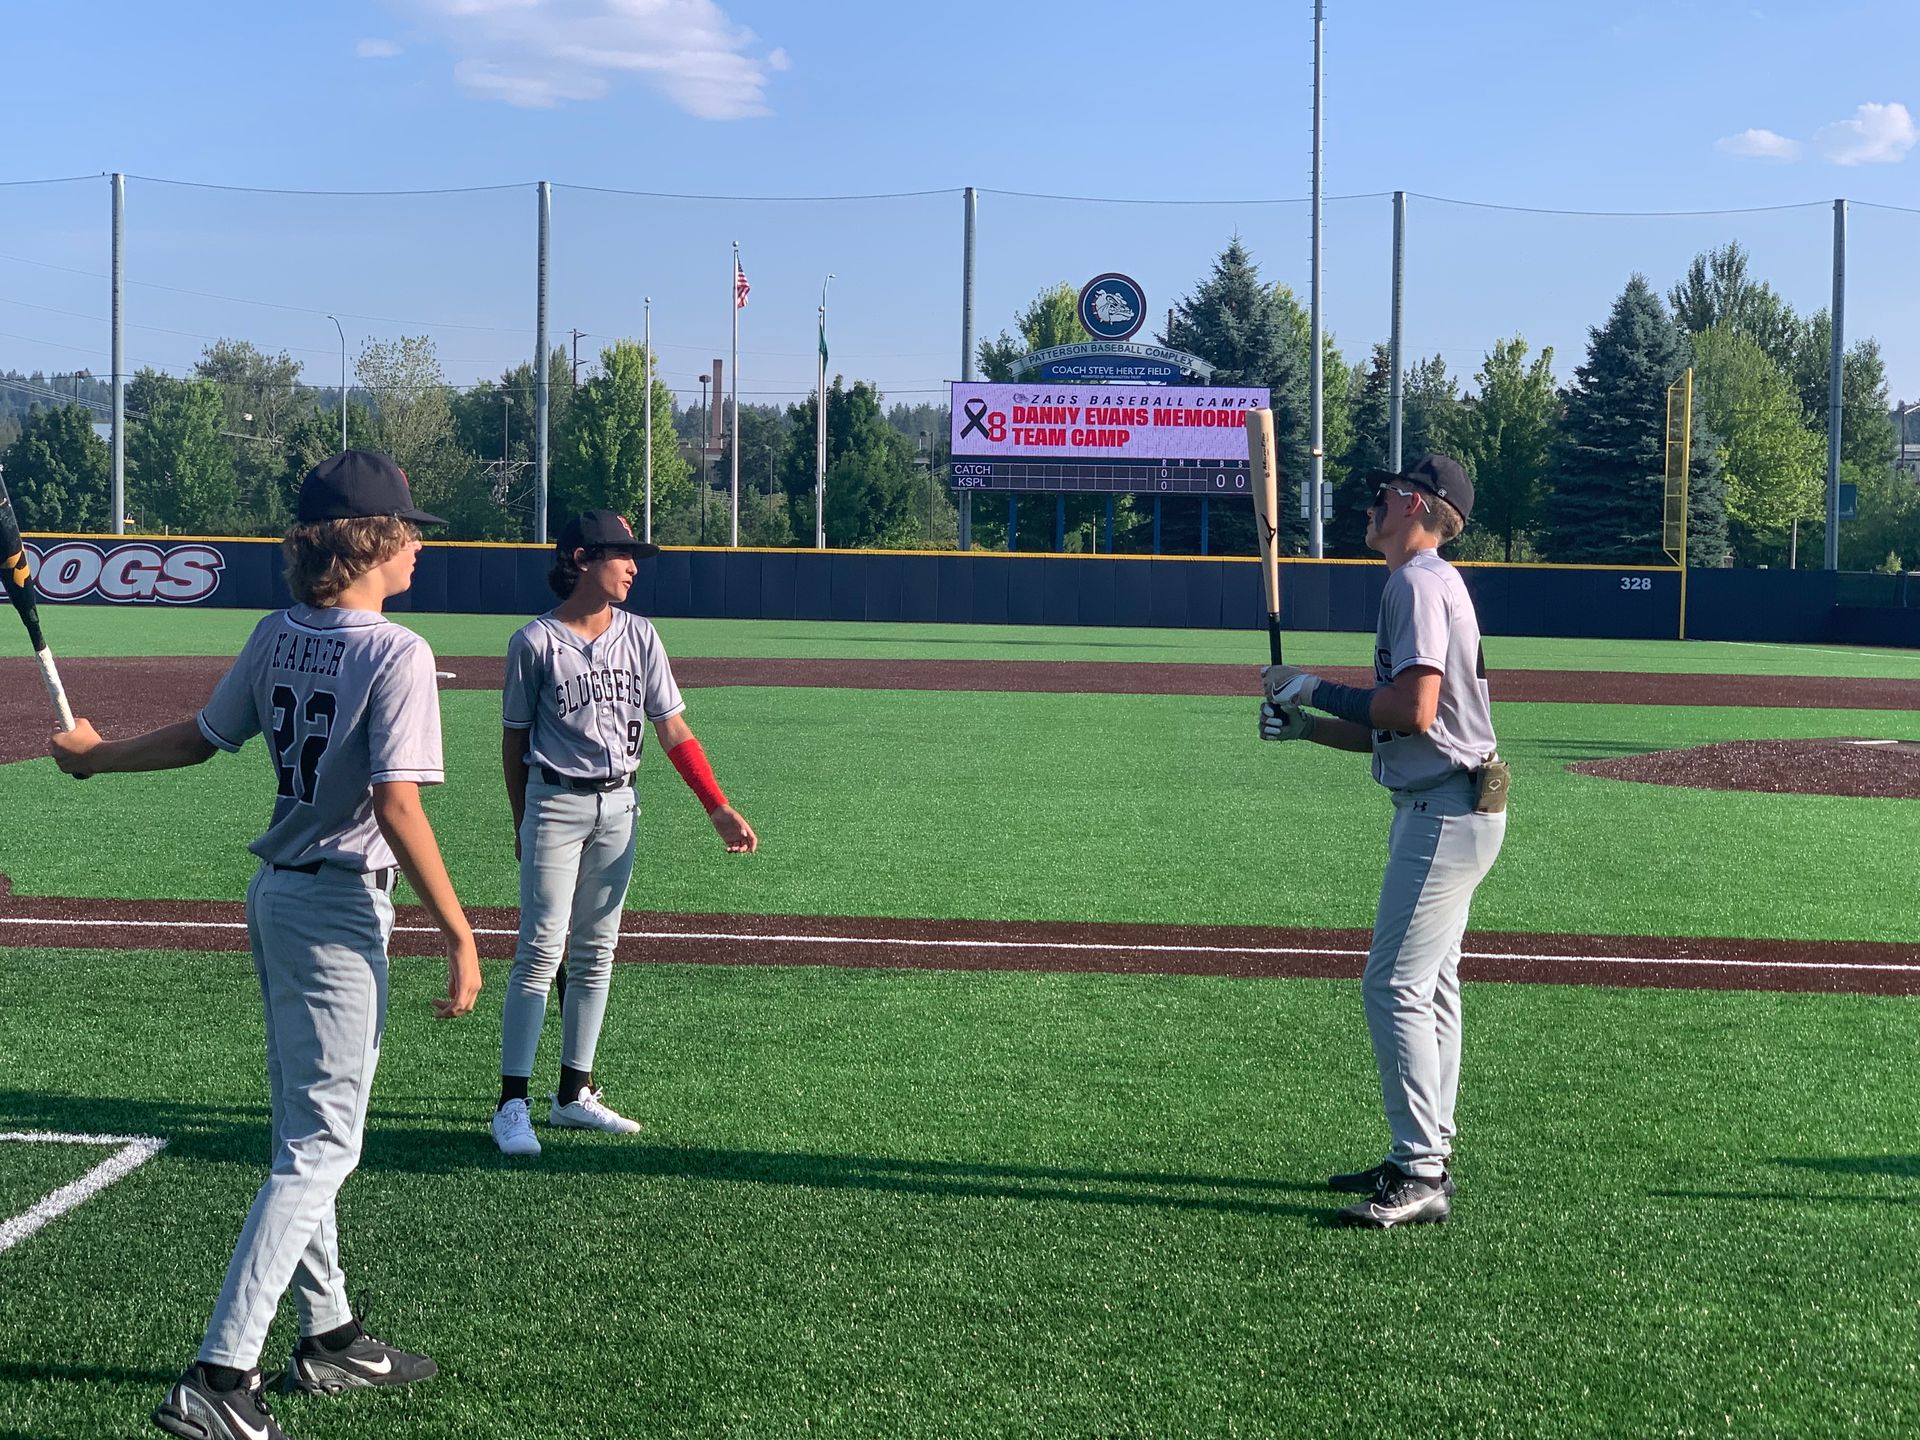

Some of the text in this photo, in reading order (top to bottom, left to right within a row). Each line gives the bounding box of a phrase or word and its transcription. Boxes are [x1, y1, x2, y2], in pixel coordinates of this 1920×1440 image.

[1028, 344, 1195, 367] PATTERSON BASEBALL COMPLEX
[1051, 366, 1172, 376] COACH STEVE HERTZ FIELD
[1031, 394, 1260, 408] ZAGS BASEBALL CAMPS
[1012, 406, 1247, 428] DANNY EVANS MEMORIA
[987, 411, 1007, 442] 8
[1012, 427, 1131, 448] TEAM CAMP
[1162, 459, 1201, 468] R H E
[1238, 460, 1243, 468] S
[954, 464, 1168, 478] CATCH 0
[958, 477, 1168, 490] KSPL 0
[1216, 474, 1245, 488] 0 0
[1620, 576, 1652, 590] 328
[555, 668, 642, 720] SLUGGERS
[271, 683, 338, 806] 22
[626, 719, 643, 757] 9
